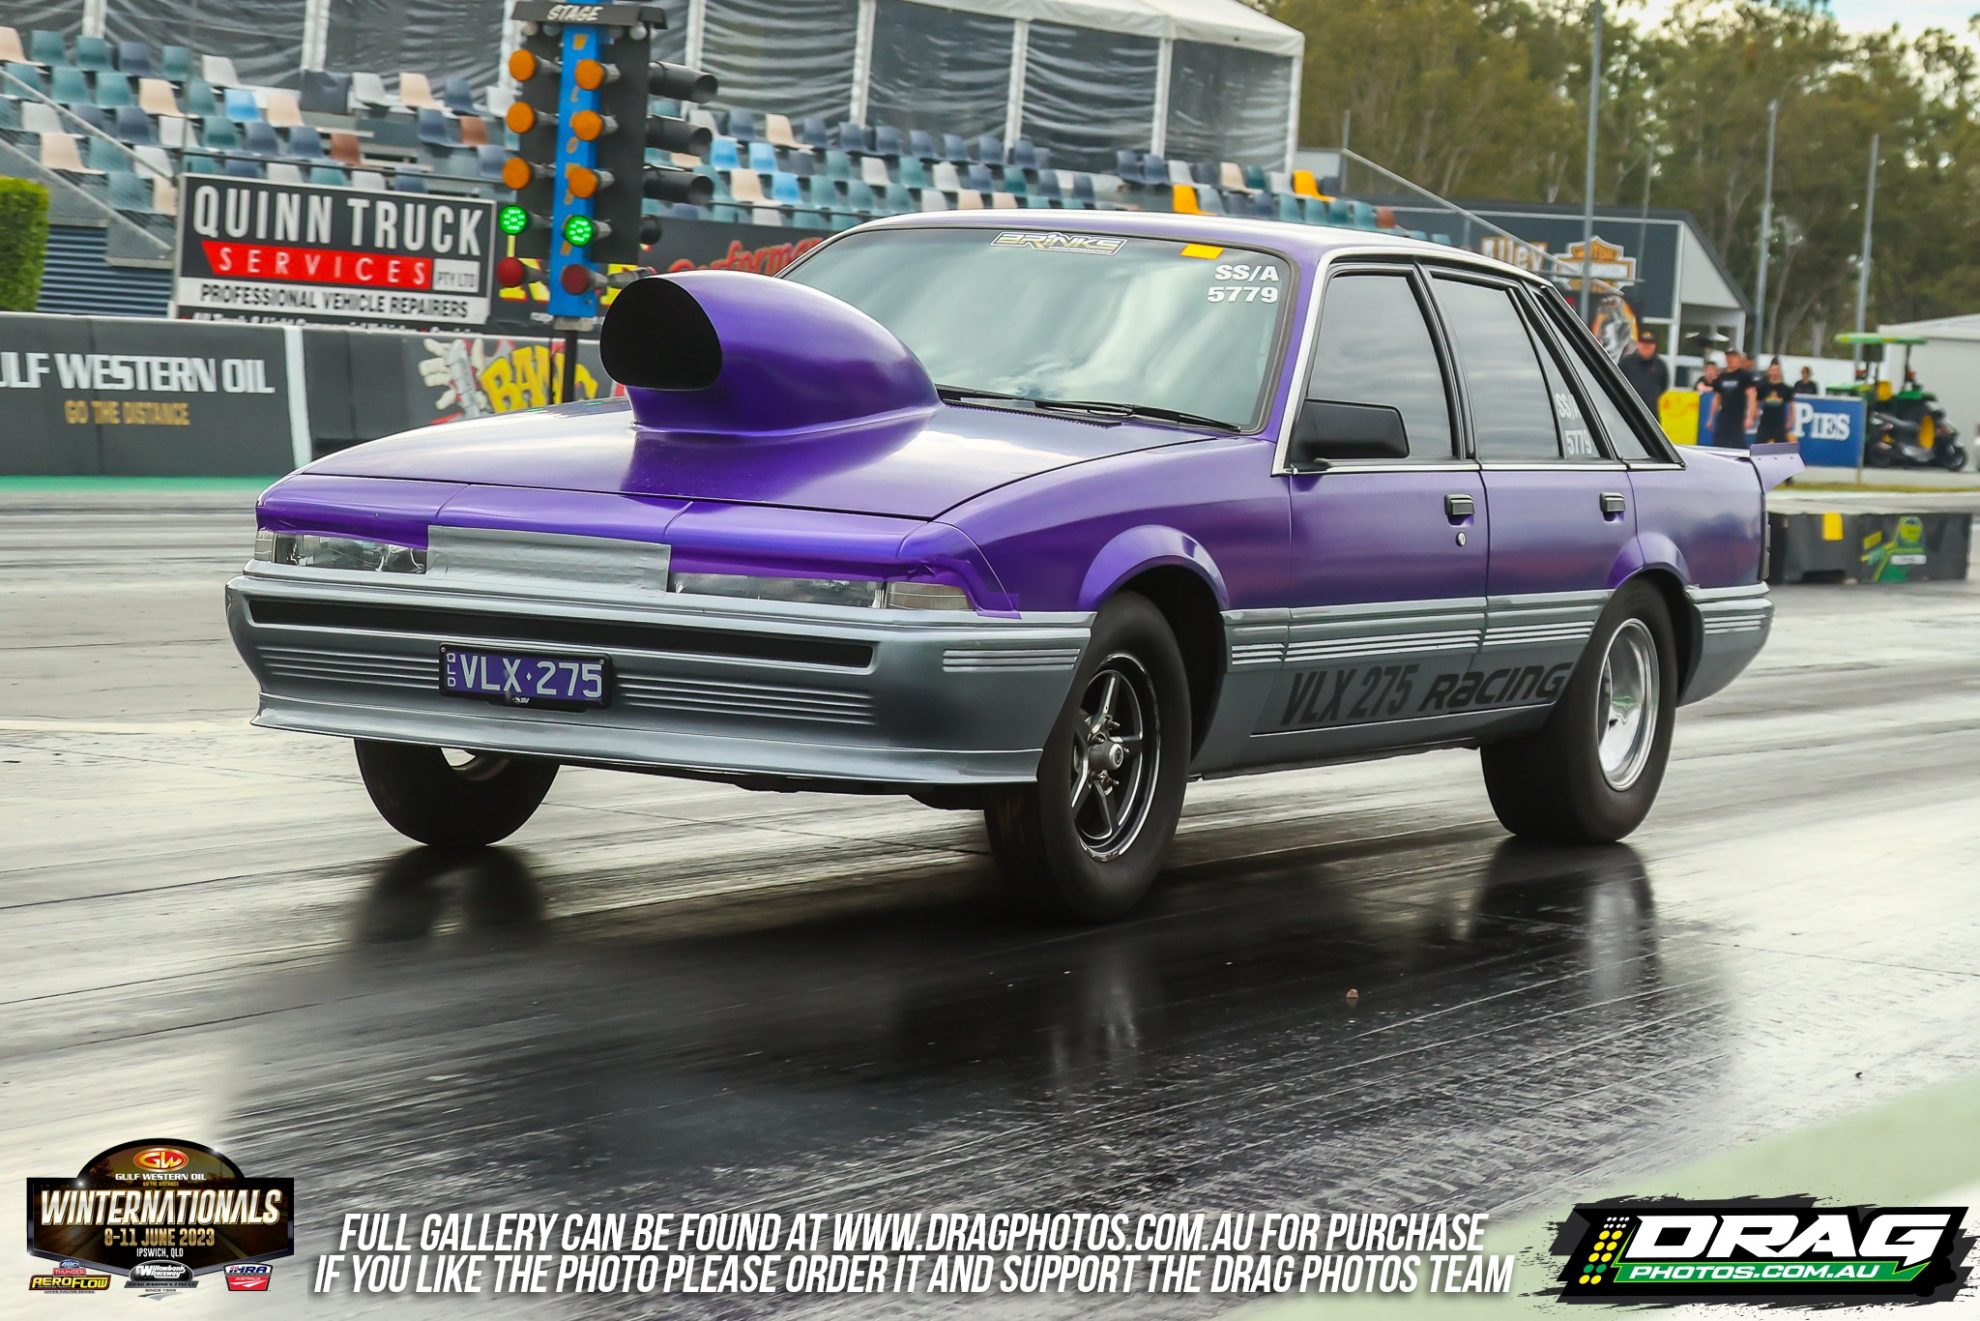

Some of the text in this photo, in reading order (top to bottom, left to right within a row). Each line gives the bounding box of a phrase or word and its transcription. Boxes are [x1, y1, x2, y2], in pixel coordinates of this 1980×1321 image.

[547, 4, 604, 21] STAGE
[193, 185, 484, 257] QUINN TRUCK
[218, 247, 426, 286] SERVICES
[1213, 264, 1280, 282] SS/A
[200, 284, 469, 318] PROFESSIONAL VEHICLE REPAIRERS
[1206, 286, 1279, 304] 5779
[54, 352, 217, 392] WESTERN
[221, 358, 275, 394] OIL
[64, 400, 191, 426] GO THE DISTANCE
[1564, 428, 1593, 456] 5779
[1280, 668, 1358, 726] VLX
[1347, 664, 1420, 719] 275
